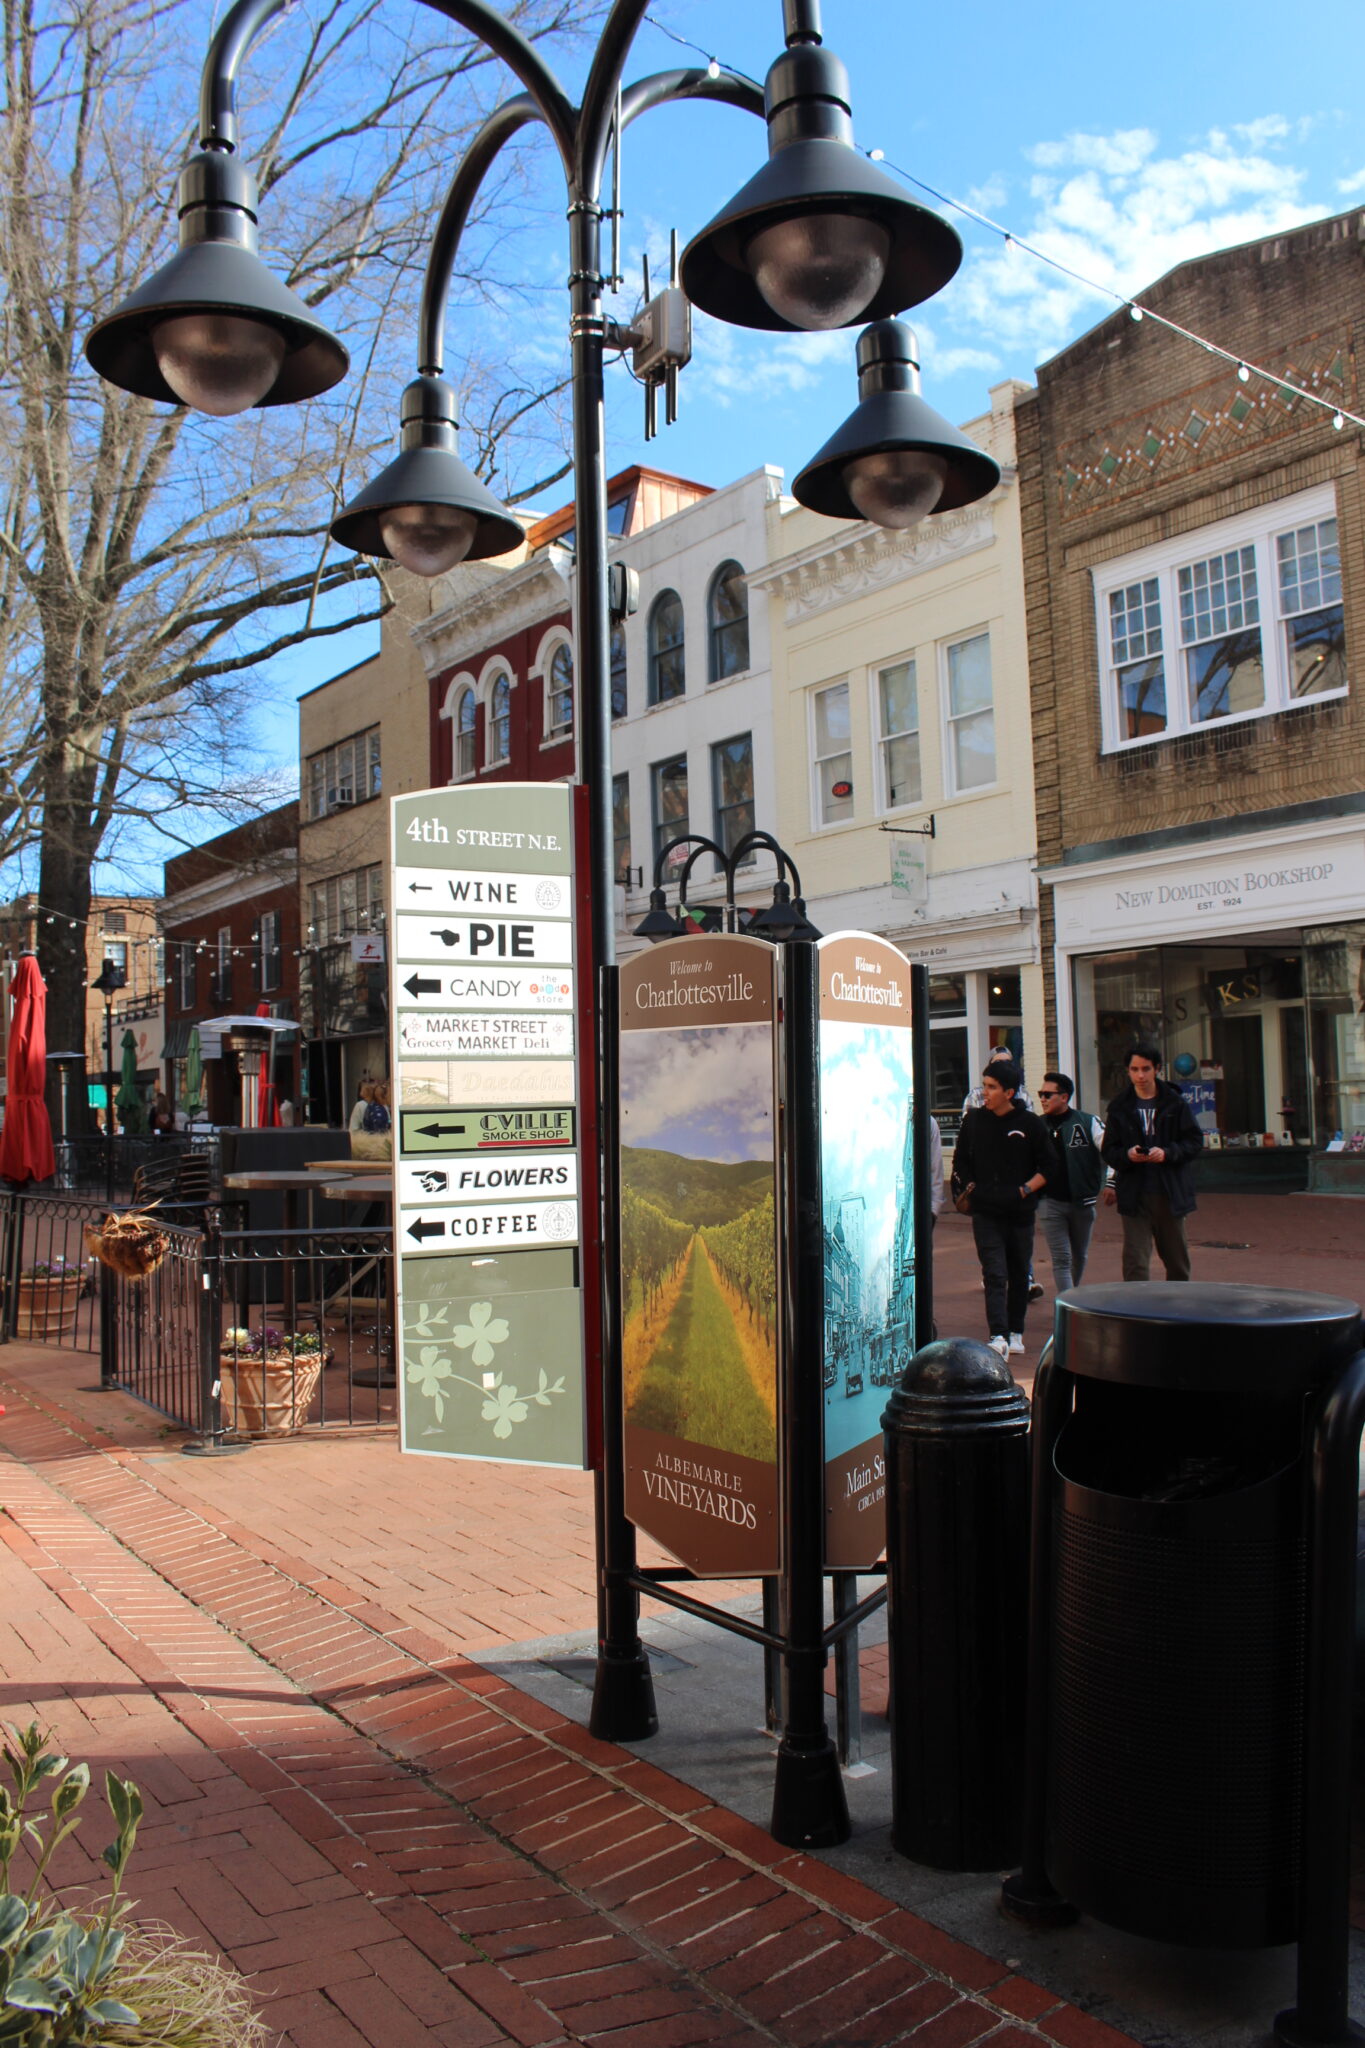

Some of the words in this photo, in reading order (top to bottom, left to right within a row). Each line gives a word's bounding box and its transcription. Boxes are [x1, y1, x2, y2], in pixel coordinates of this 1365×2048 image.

[406, 817, 450, 844] 4th
[456, 828, 525, 848] STREET
[528, 834, 562, 852] N.E.
[448, 880, 518, 904] WINE
[1222, 897, 1243, 907] 1924
[469, 922, 535, 958] PIE
[670, 960, 702, 976] Welcome
[704, 959, 713, 972] to
[855, 956, 876, 974] Welcome
[876, 962, 881, 975] to
[450, 979, 522, 997] CANDY
[541, 975, 557, 983] the
[536, 995, 563, 1003] store
[635, 973, 753, 1009] Charlottesville
[831, 972, 903, 1008] Charlottesville
[426, 1019, 489, 1033] MARKET
[493, 1020, 548, 1034] STREET
[406, 1037, 454, 1050] Grocery
[458, 1036, 517, 1049] MARKET
[524, 1038, 549, 1049] Deli
[480, 1112, 568, 1131] CVILLE
[482, 1130, 527, 1141] SMOKE
[529, 1129, 563, 1139] SHOP
[1069, 1124, 1089, 1148] A
[459, 1166, 568, 1189] FLOWERS
[451, 1215, 537, 1236] COFFEE
[655, 1451, 743, 1493] ALBEMARLE
[845, 1463, 872, 1497] Main
[642, 1469, 757, 1530] VINEYARDS
